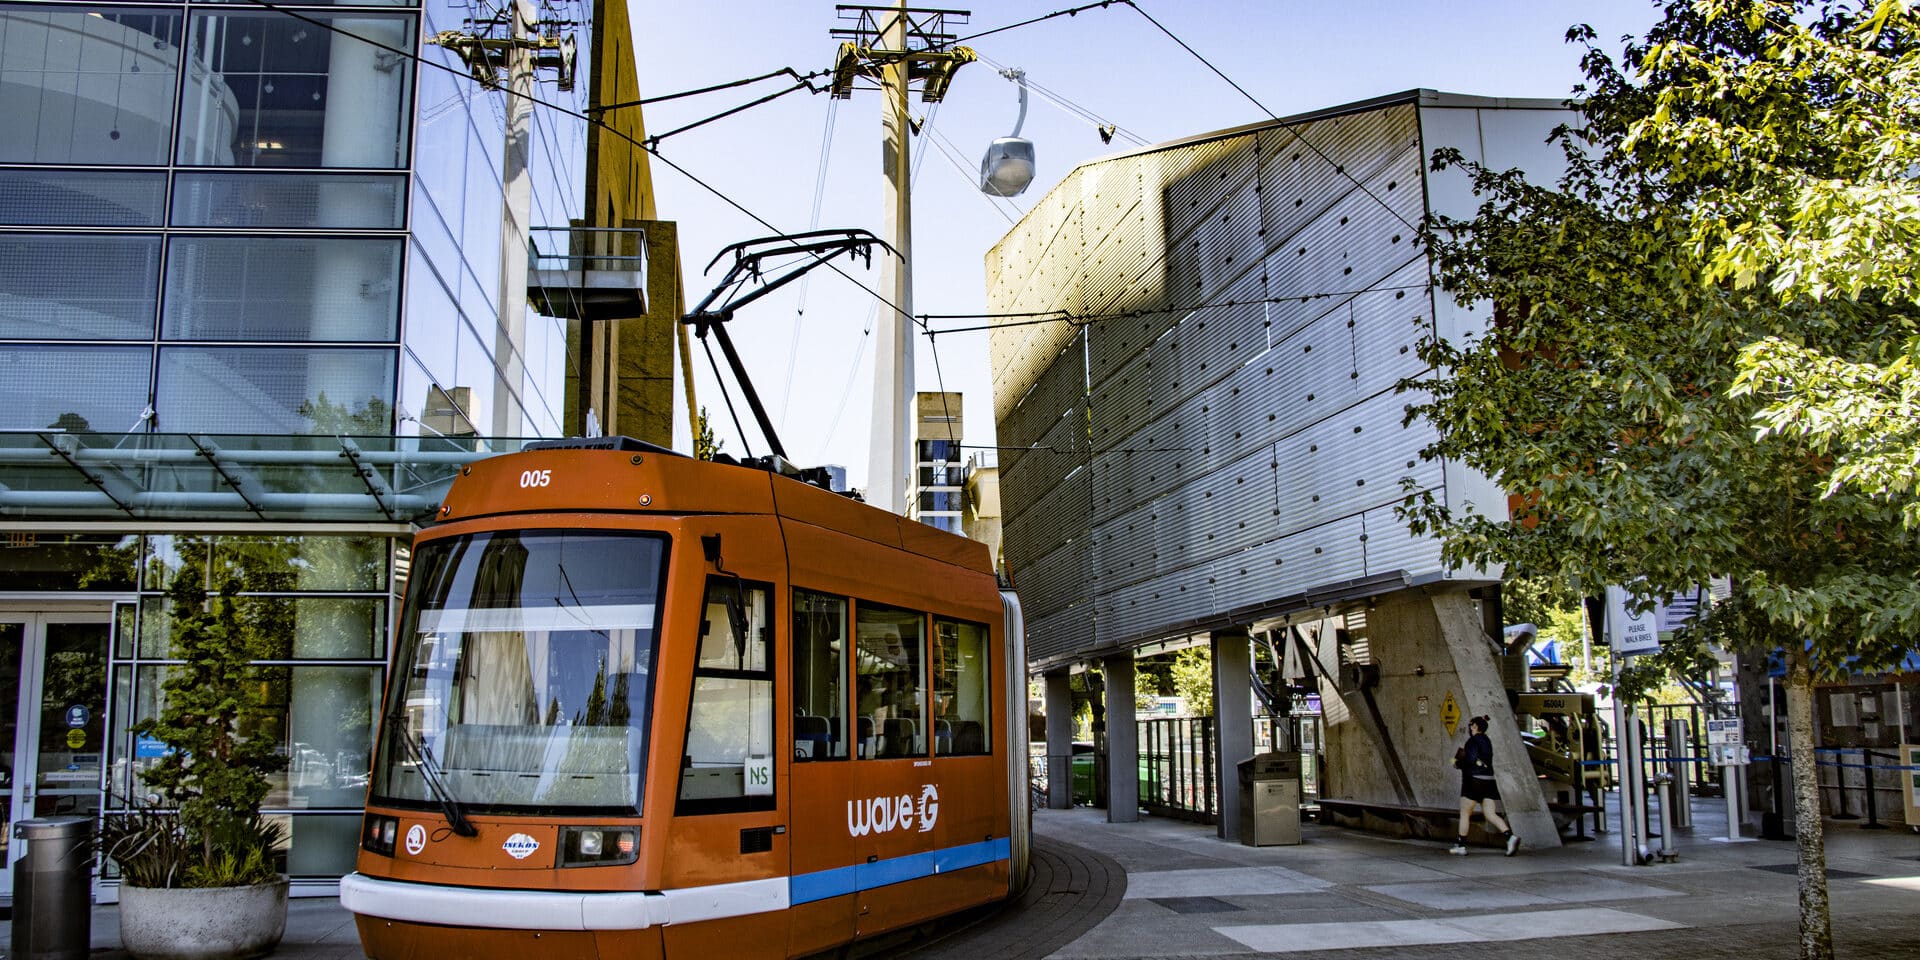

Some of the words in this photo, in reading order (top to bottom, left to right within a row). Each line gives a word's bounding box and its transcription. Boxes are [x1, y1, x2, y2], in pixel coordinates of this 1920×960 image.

[520, 469, 552, 488] 005
[1628, 624, 1646, 632] PLEASE
[1624, 635, 1638, 643] WALK
[1639, 633, 1652, 642] BIKES
[750, 766, 768, 785] NS
